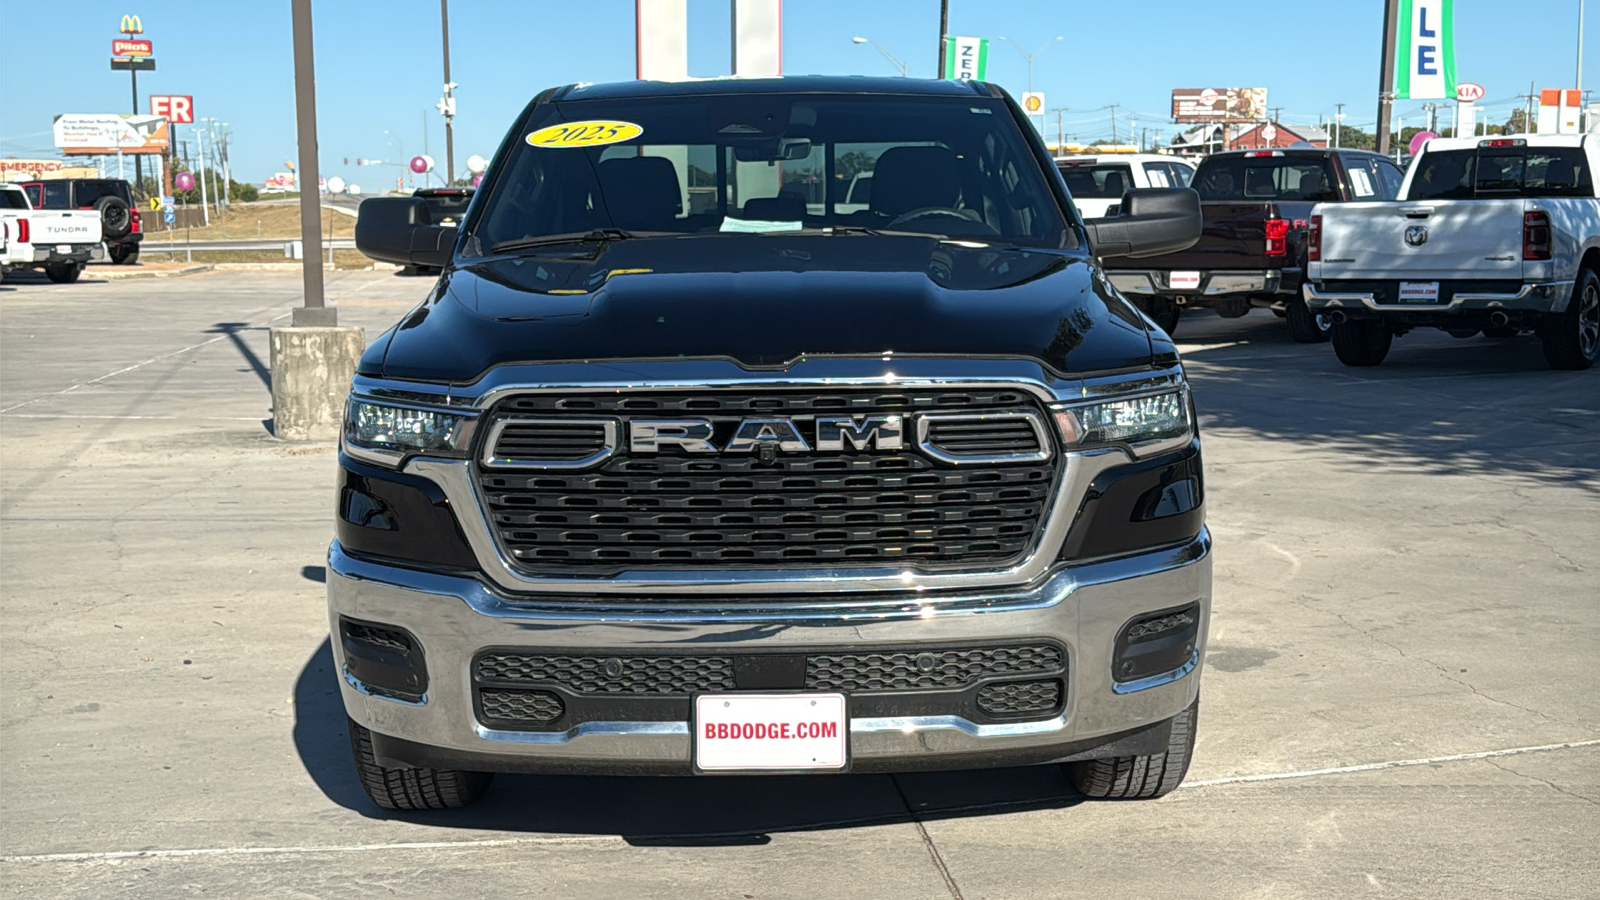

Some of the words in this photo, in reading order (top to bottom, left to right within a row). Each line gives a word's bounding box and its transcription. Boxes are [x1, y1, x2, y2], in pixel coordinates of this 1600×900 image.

[115, 42, 149, 52] Pilot
[151, 96, 190, 122] ER
[543, 125, 626, 143] 2025
[0, 162, 62, 172] EMERGENCY
[630, 415, 903, 452] RAM
[705, 722, 837, 739] BBDODGE.COM
